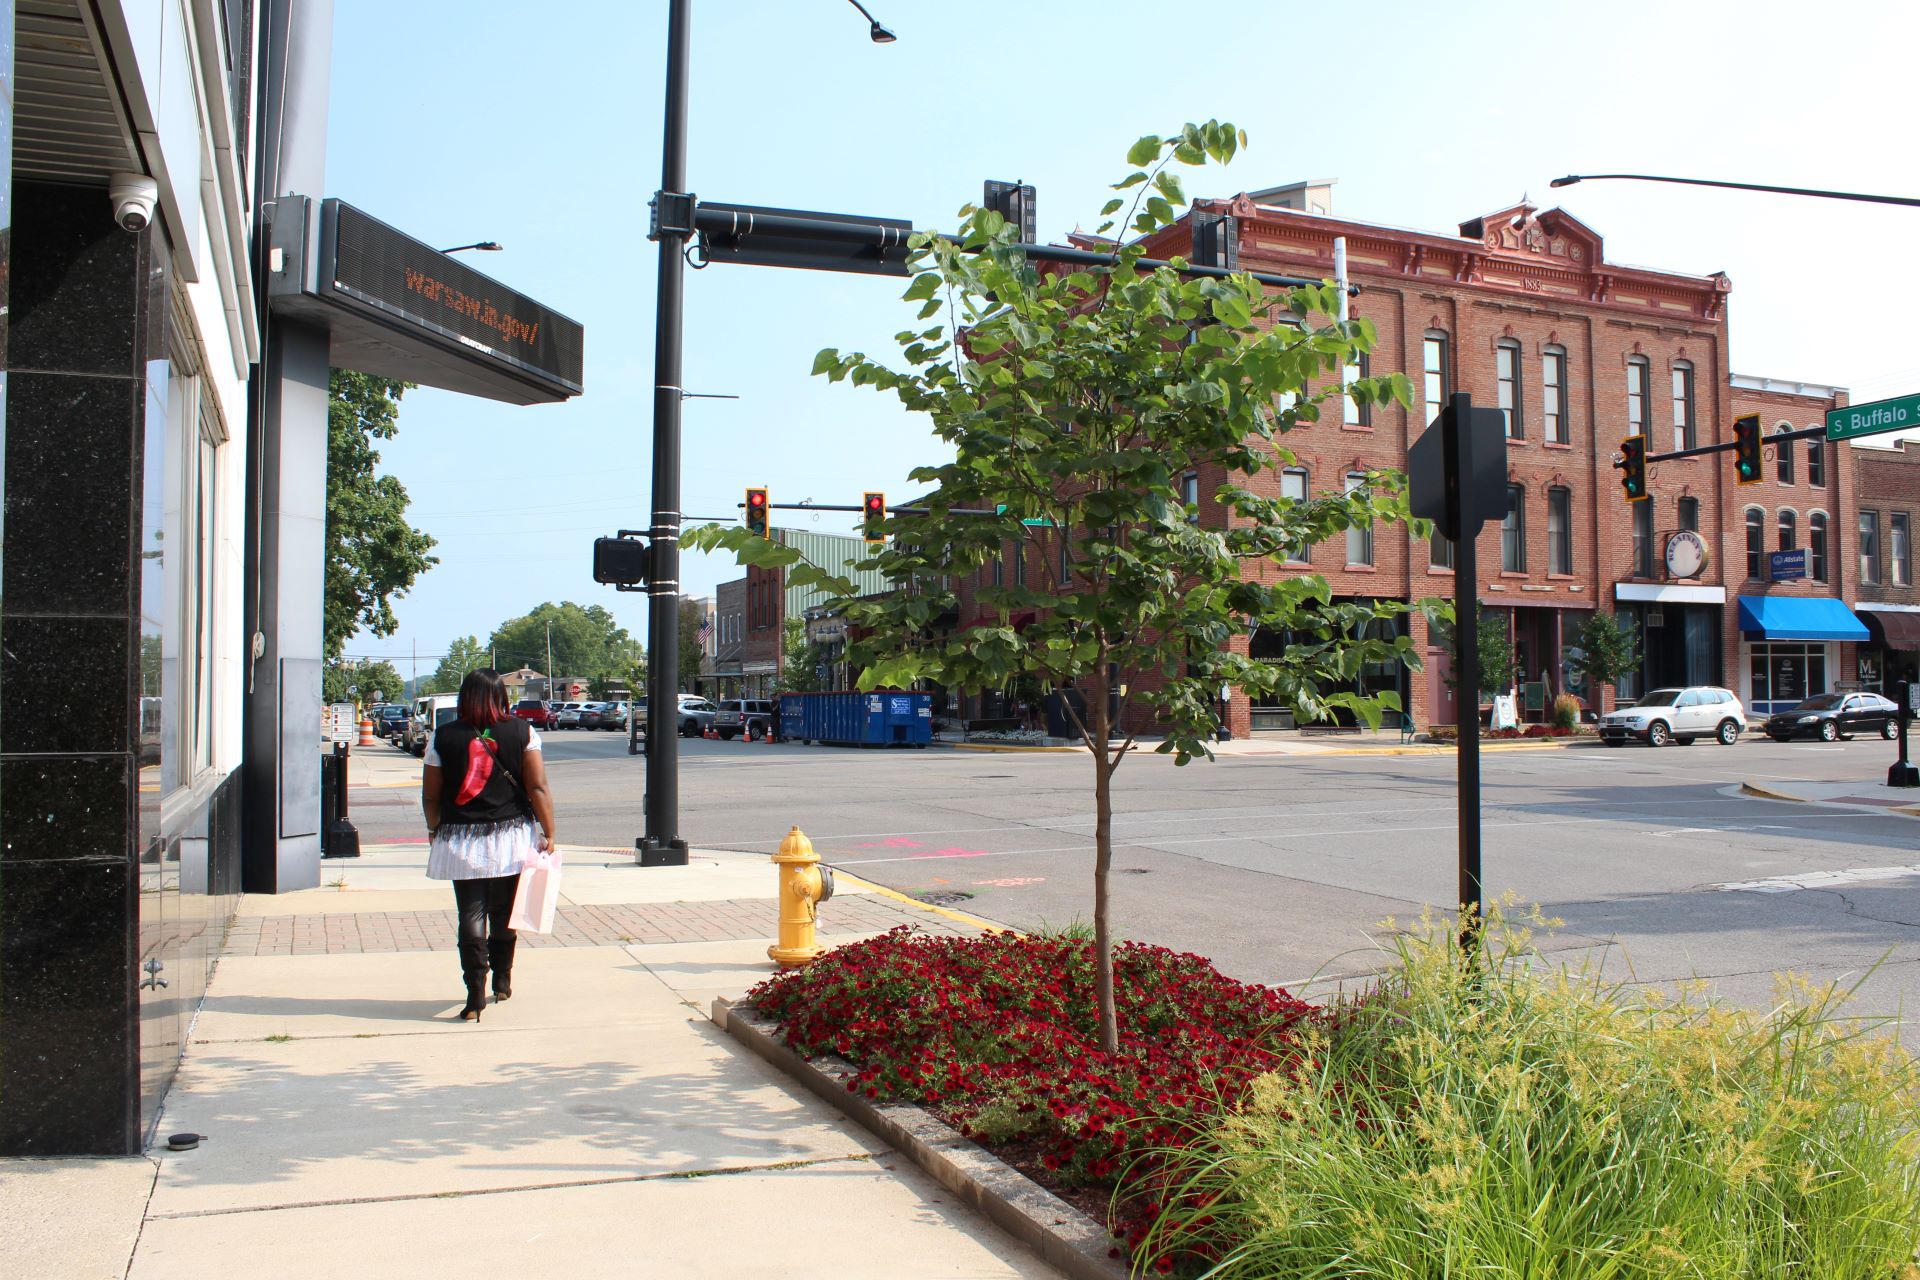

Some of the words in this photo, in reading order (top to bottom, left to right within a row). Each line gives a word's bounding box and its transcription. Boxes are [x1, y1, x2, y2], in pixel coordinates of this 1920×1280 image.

[404, 266, 539, 345] warsaw.in.gov/
[1834, 419, 1843, 432] S
[1850, 406, 1907, 430] Buffalo
